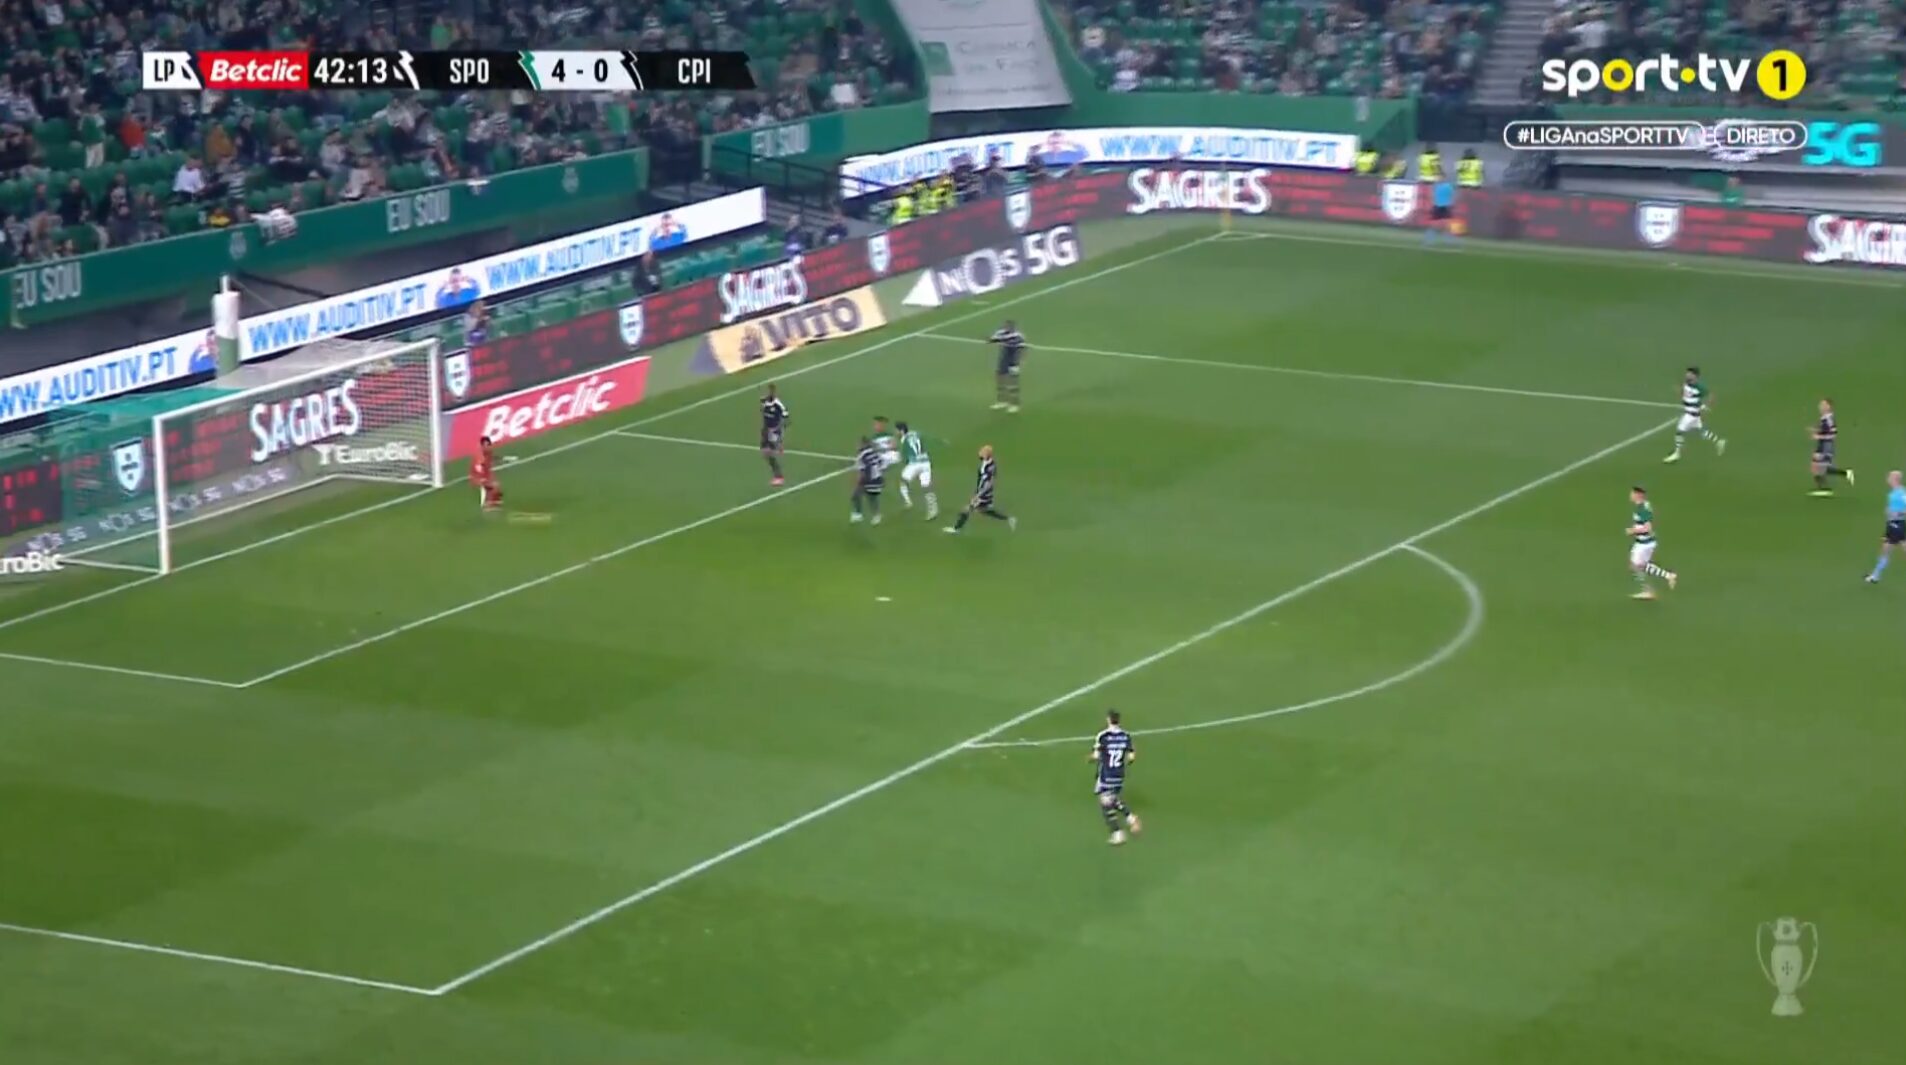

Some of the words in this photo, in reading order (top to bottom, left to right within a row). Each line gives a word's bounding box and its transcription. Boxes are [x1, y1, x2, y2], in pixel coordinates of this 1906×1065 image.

[1803, 121, 1880, 167] 5G
[386, 196, 411, 232] EU
[414, 188, 451, 226] SOU
[1126, 167, 1272, 214] SAGRES
[1023, 227, 1080, 276] 5G
[40, 261, 82, 302] SOU
[718, 255, 808, 324] SAGRES
[249, 283, 427, 353] WWW.AUDITIV.PT
[760, 296, 863, 352] VITO
[249, 378, 363, 463] SAGRES
[484, 374, 617, 440] Betclic
